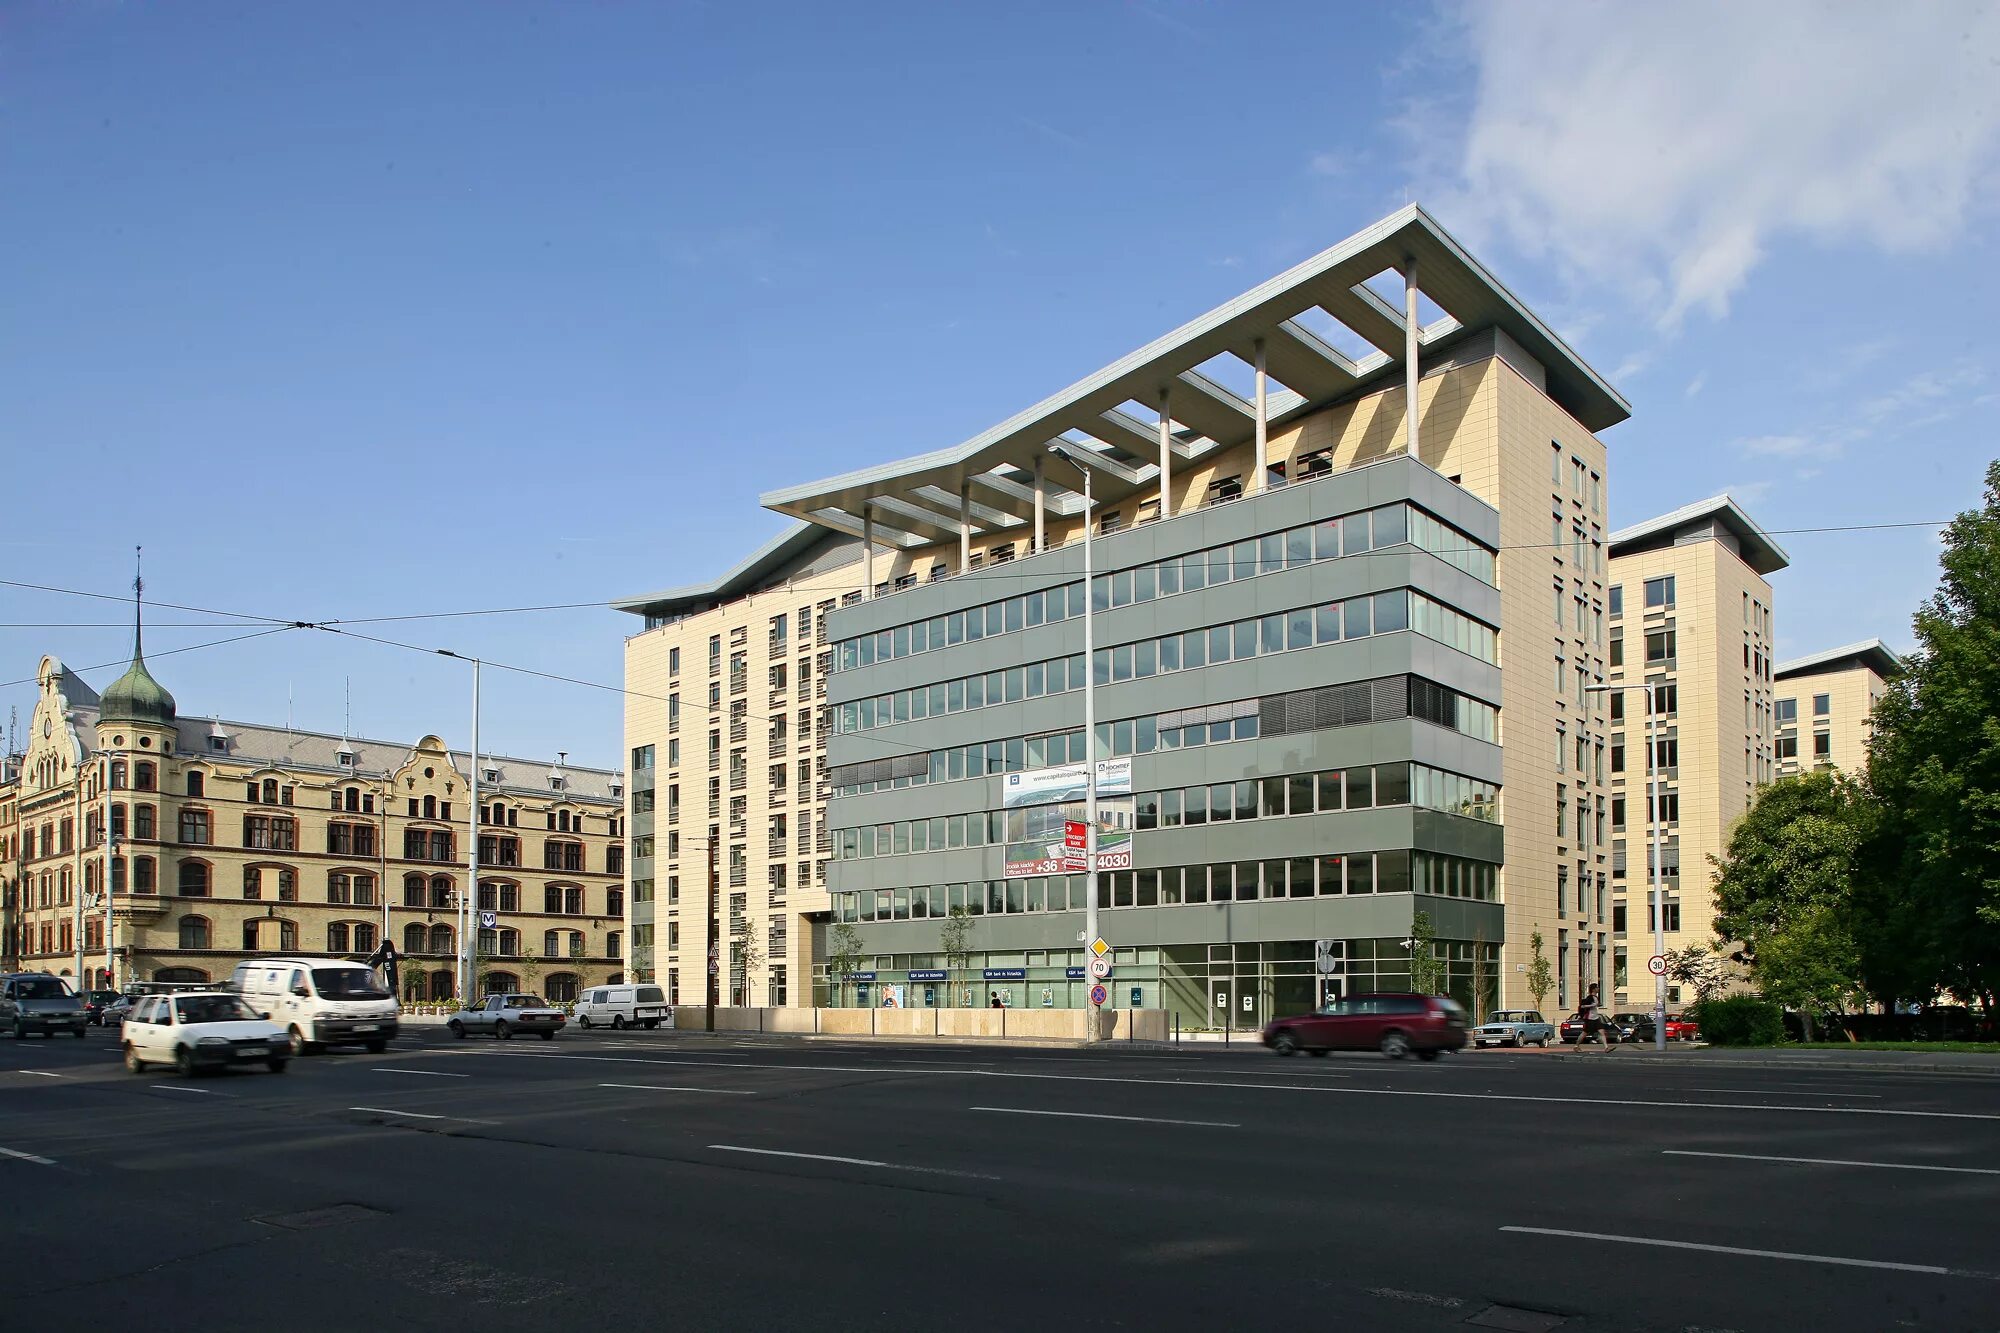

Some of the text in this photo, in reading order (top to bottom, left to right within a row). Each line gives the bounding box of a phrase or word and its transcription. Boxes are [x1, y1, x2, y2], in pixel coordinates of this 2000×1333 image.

[1105, 762, 1130, 771] HOCHTIEF
[1036, 860, 1058, 872] +36
[1097, 854, 1129, 868] 4030
[1095, 963, 1104, 972] 70
[1652, 961, 1663, 970] 30
